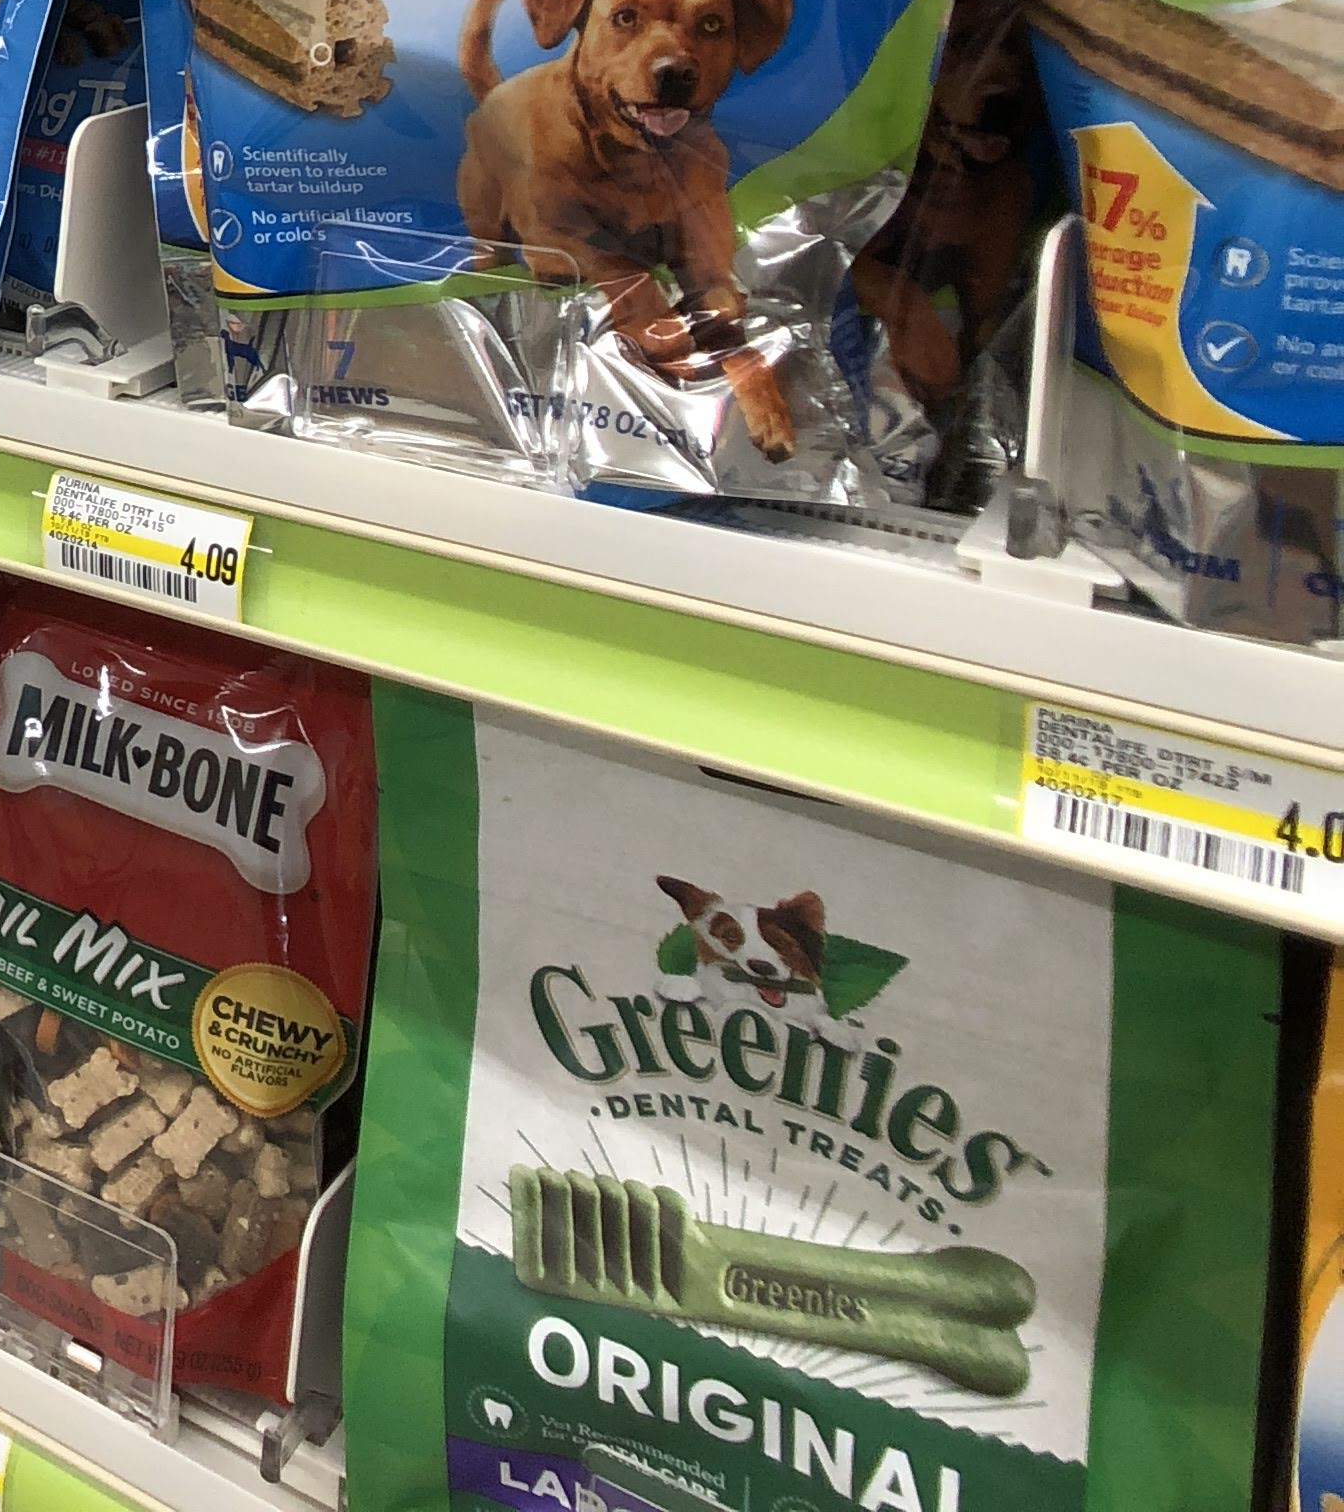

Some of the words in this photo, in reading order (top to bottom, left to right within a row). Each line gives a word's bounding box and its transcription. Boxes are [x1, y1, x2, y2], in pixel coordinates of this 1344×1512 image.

[241, 145, 349, 166] Scientifically
[243, 163, 301, 181] proven
[303, 163, 322, 177] to
[325, 162, 388, 178] reduce
[246, 180, 295, 194] tartar
[298, 179, 365, 196] buildup
[251, 210, 277, 226] No
[278, 209, 351, 225] artificial
[353, 208, 414, 225] flavors
[253, 231, 270, 244] or
[57, 476, 102, 495] PURINA
[55, 485, 118, 510] DENTALIFE
[120, 501, 155, 519] DTRT
[158, 510, 176, 525] LG
[48, 530, 99, 551] 4020214
[179, 536, 239, 587] 4.09
[139, 685, 200, 717] SINCE
[50, 980, 109, 1023] SWEET
[111, 1009, 181, 1051] POTATO
[210, 994, 335, 1054] CHEWY
[224, 1025, 325, 1068] CRUNCHY
[528, 962, 1049, 1209] Greenies
[607, 1092, 767, 1138] DENTAL
[780, 1118, 950, 1226] TREATS
[722, 1263, 872, 1324] Greenies
